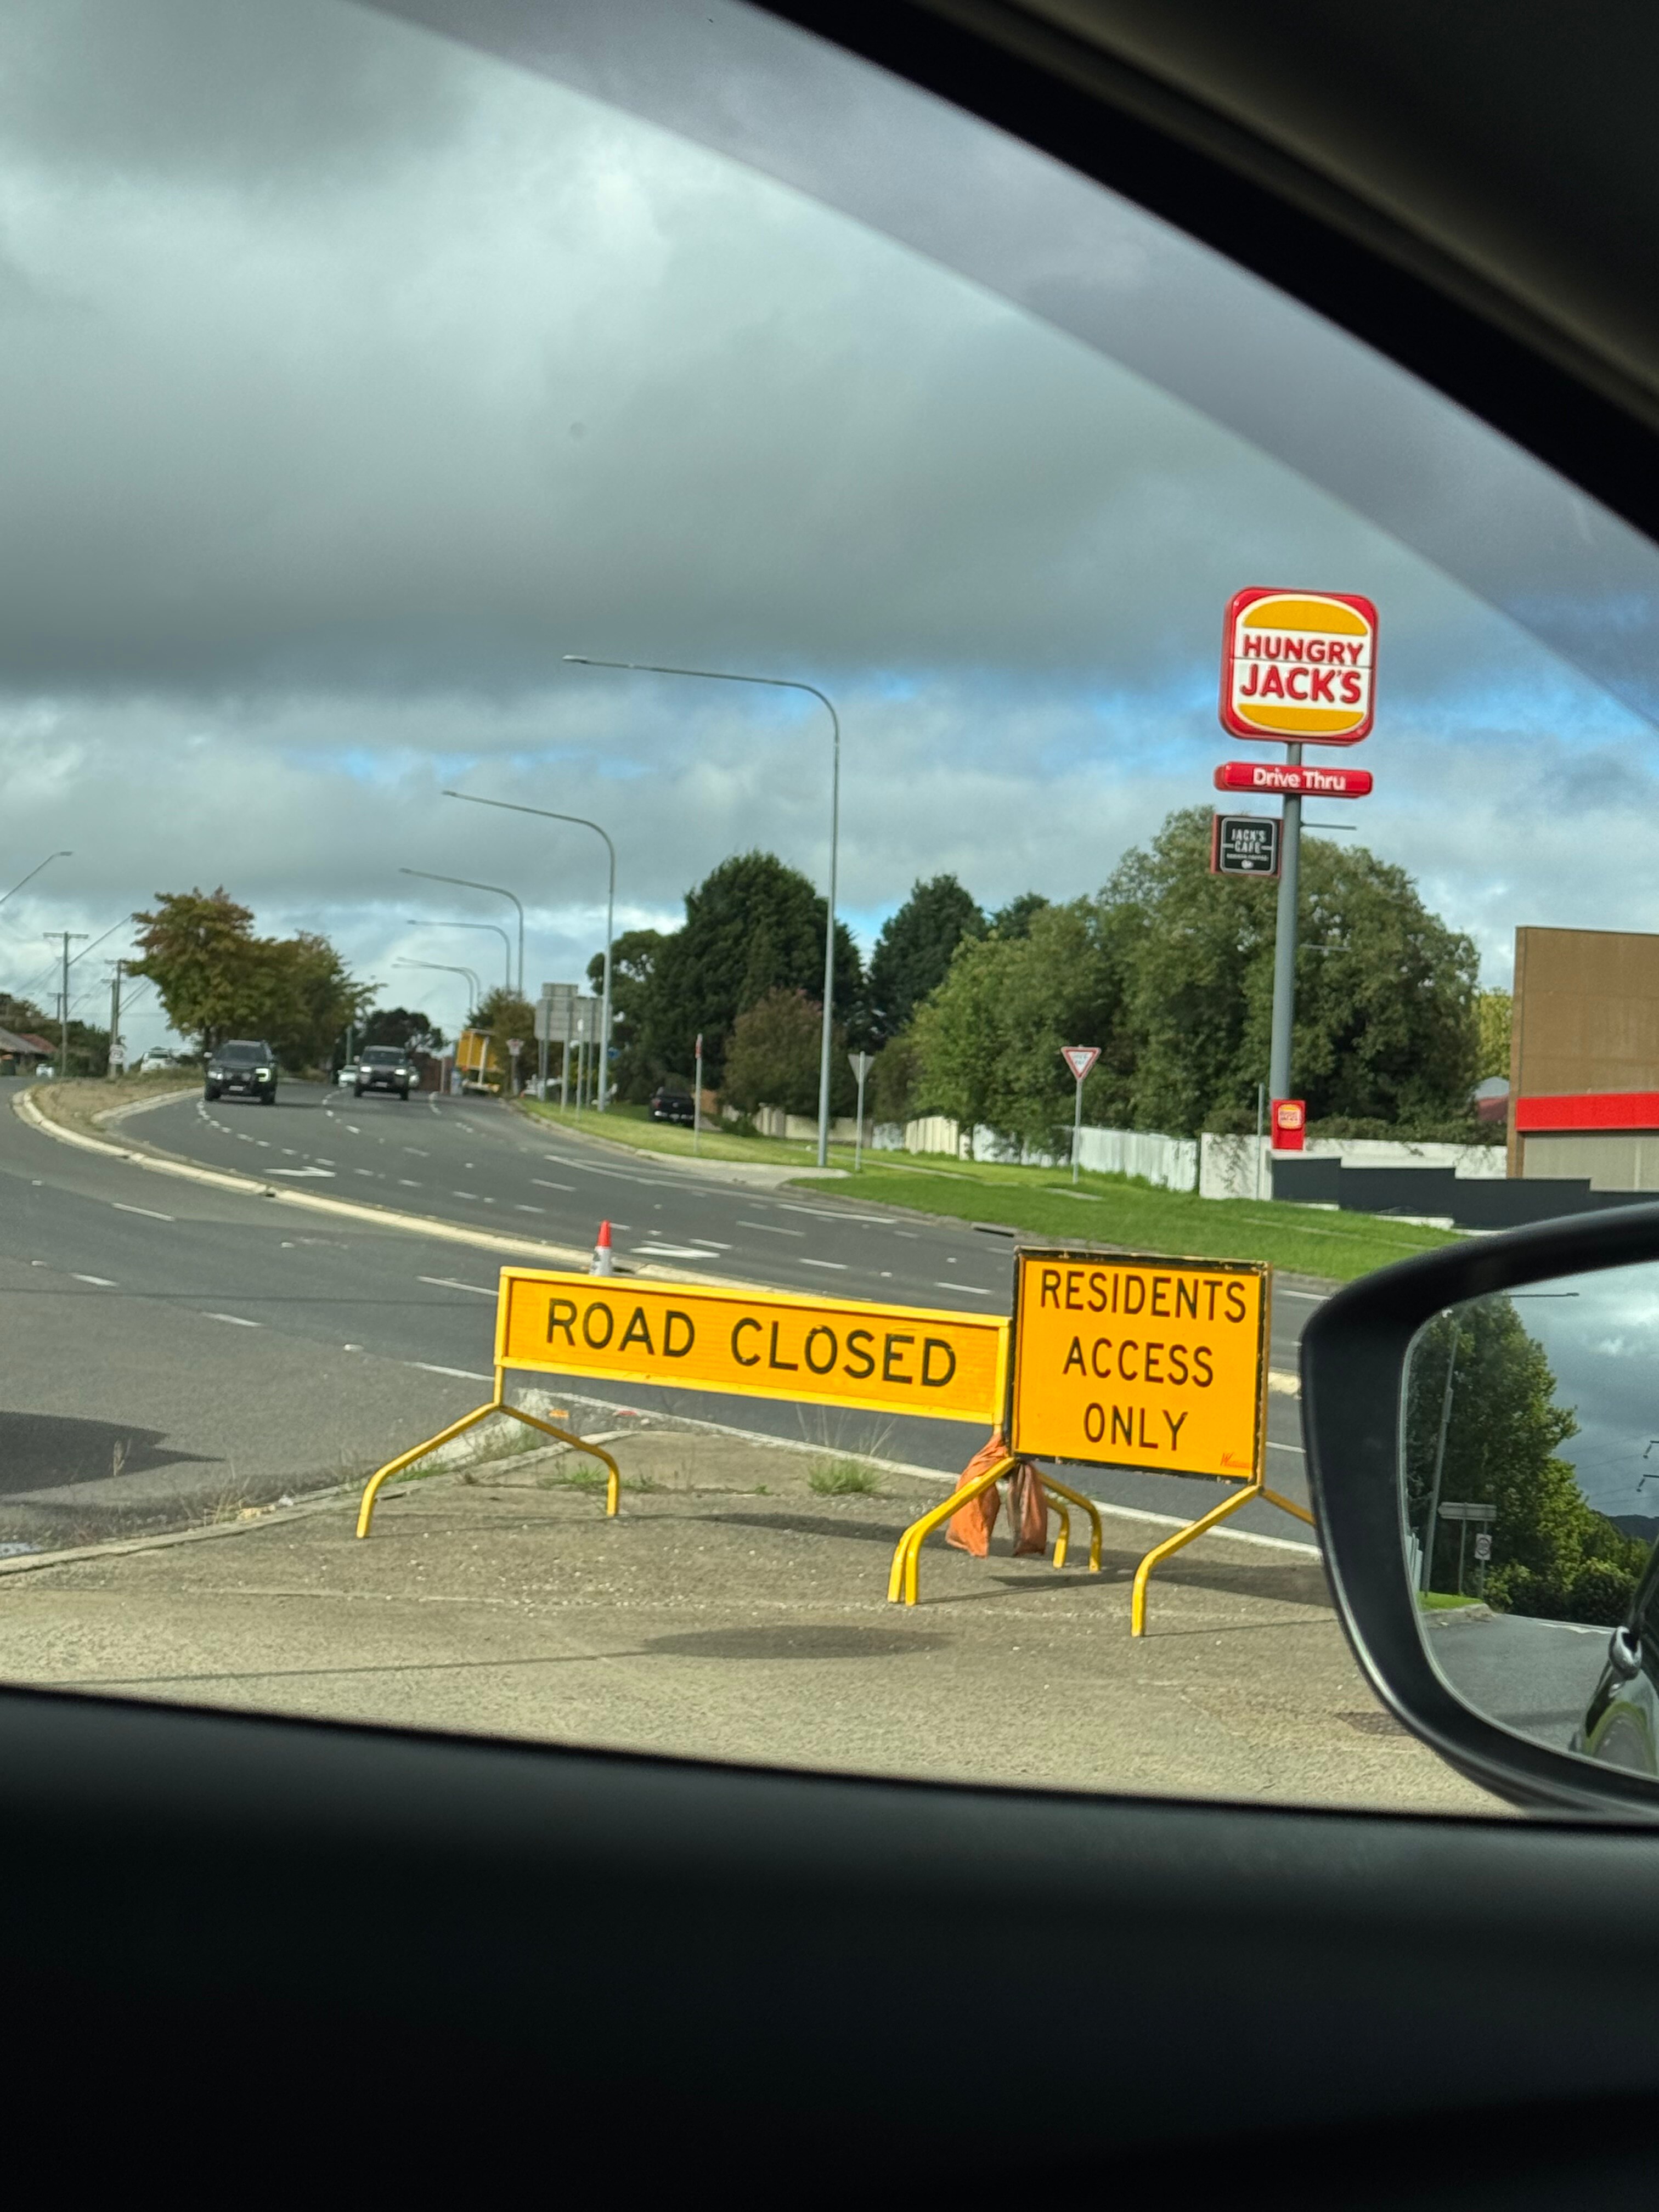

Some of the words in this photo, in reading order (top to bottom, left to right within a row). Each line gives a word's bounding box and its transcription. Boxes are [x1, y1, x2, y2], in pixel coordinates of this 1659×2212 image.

[1243, 634, 1363, 665] HUNGRY
[1240, 663, 1361, 704] JACK'S
[1253, 768, 1301, 788] Drive
[1302, 770, 1346, 791] Thru
[1231, 828, 1266, 843] JACK'S
[1041, 1269, 1246, 1323] RESIDENTS
[547, 1298, 695, 1358] ROAD
[731, 1317, 956, 1387] CLOSED
[1063, 1336, 1213, 1387] ACCESS
[1084, 1402, 1187, 1451] ONLY
